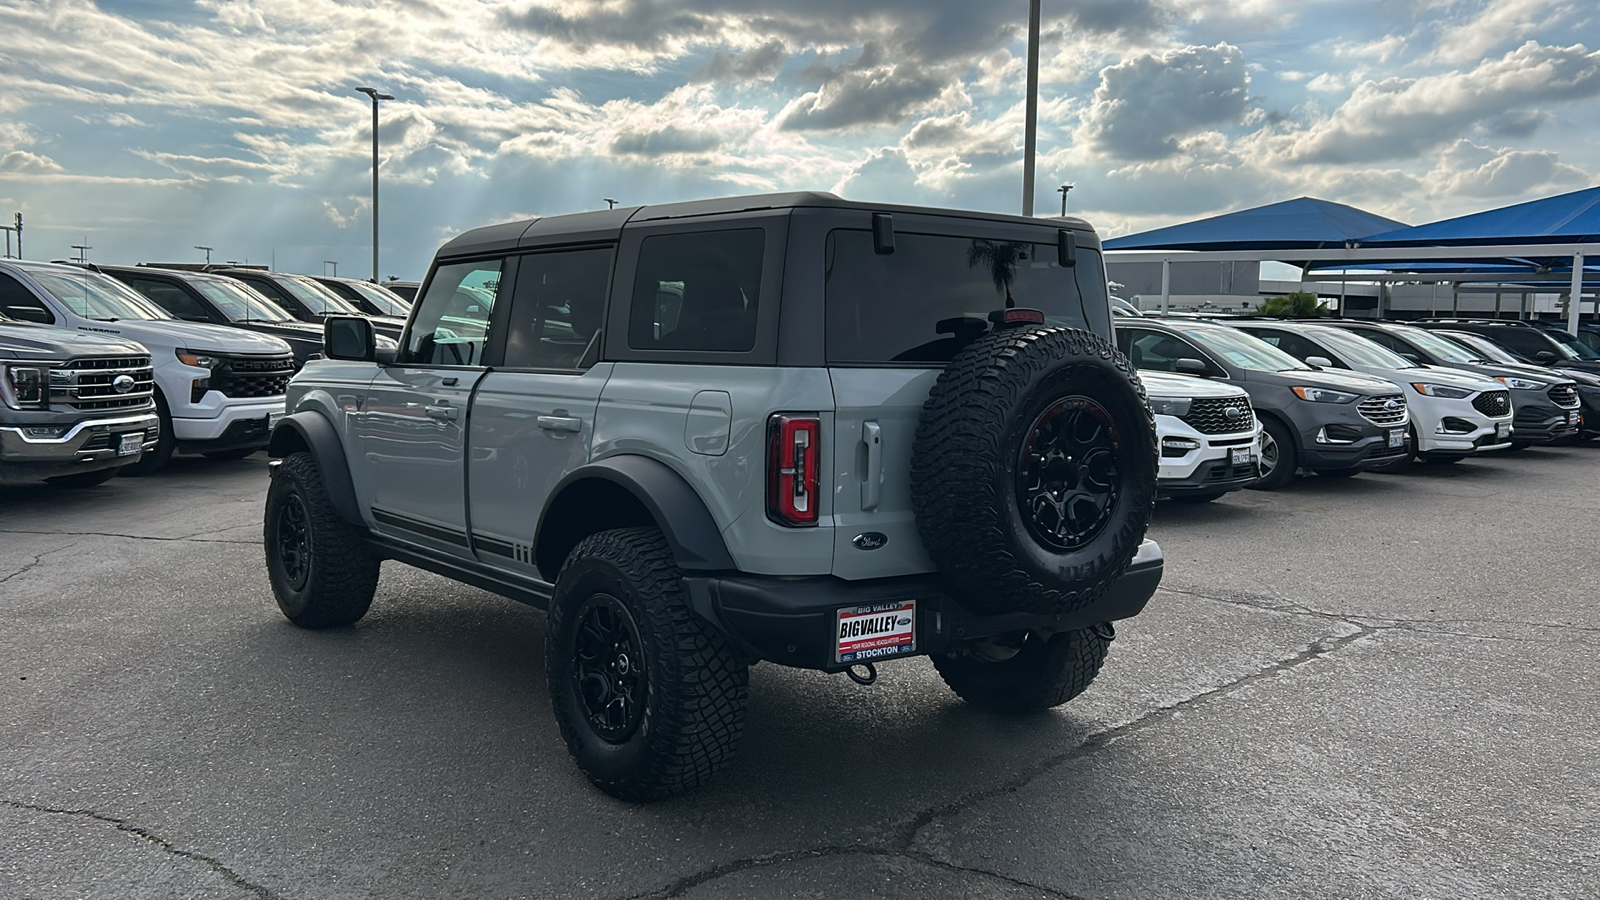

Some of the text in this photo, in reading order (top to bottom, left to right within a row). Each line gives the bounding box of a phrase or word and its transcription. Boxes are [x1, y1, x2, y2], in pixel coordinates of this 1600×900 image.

[78, 326, 121, 334] SILVERADO
[857, 603, 898, 614] BIG VALLEY
[856, 646, 898, 659] STOCKTON
